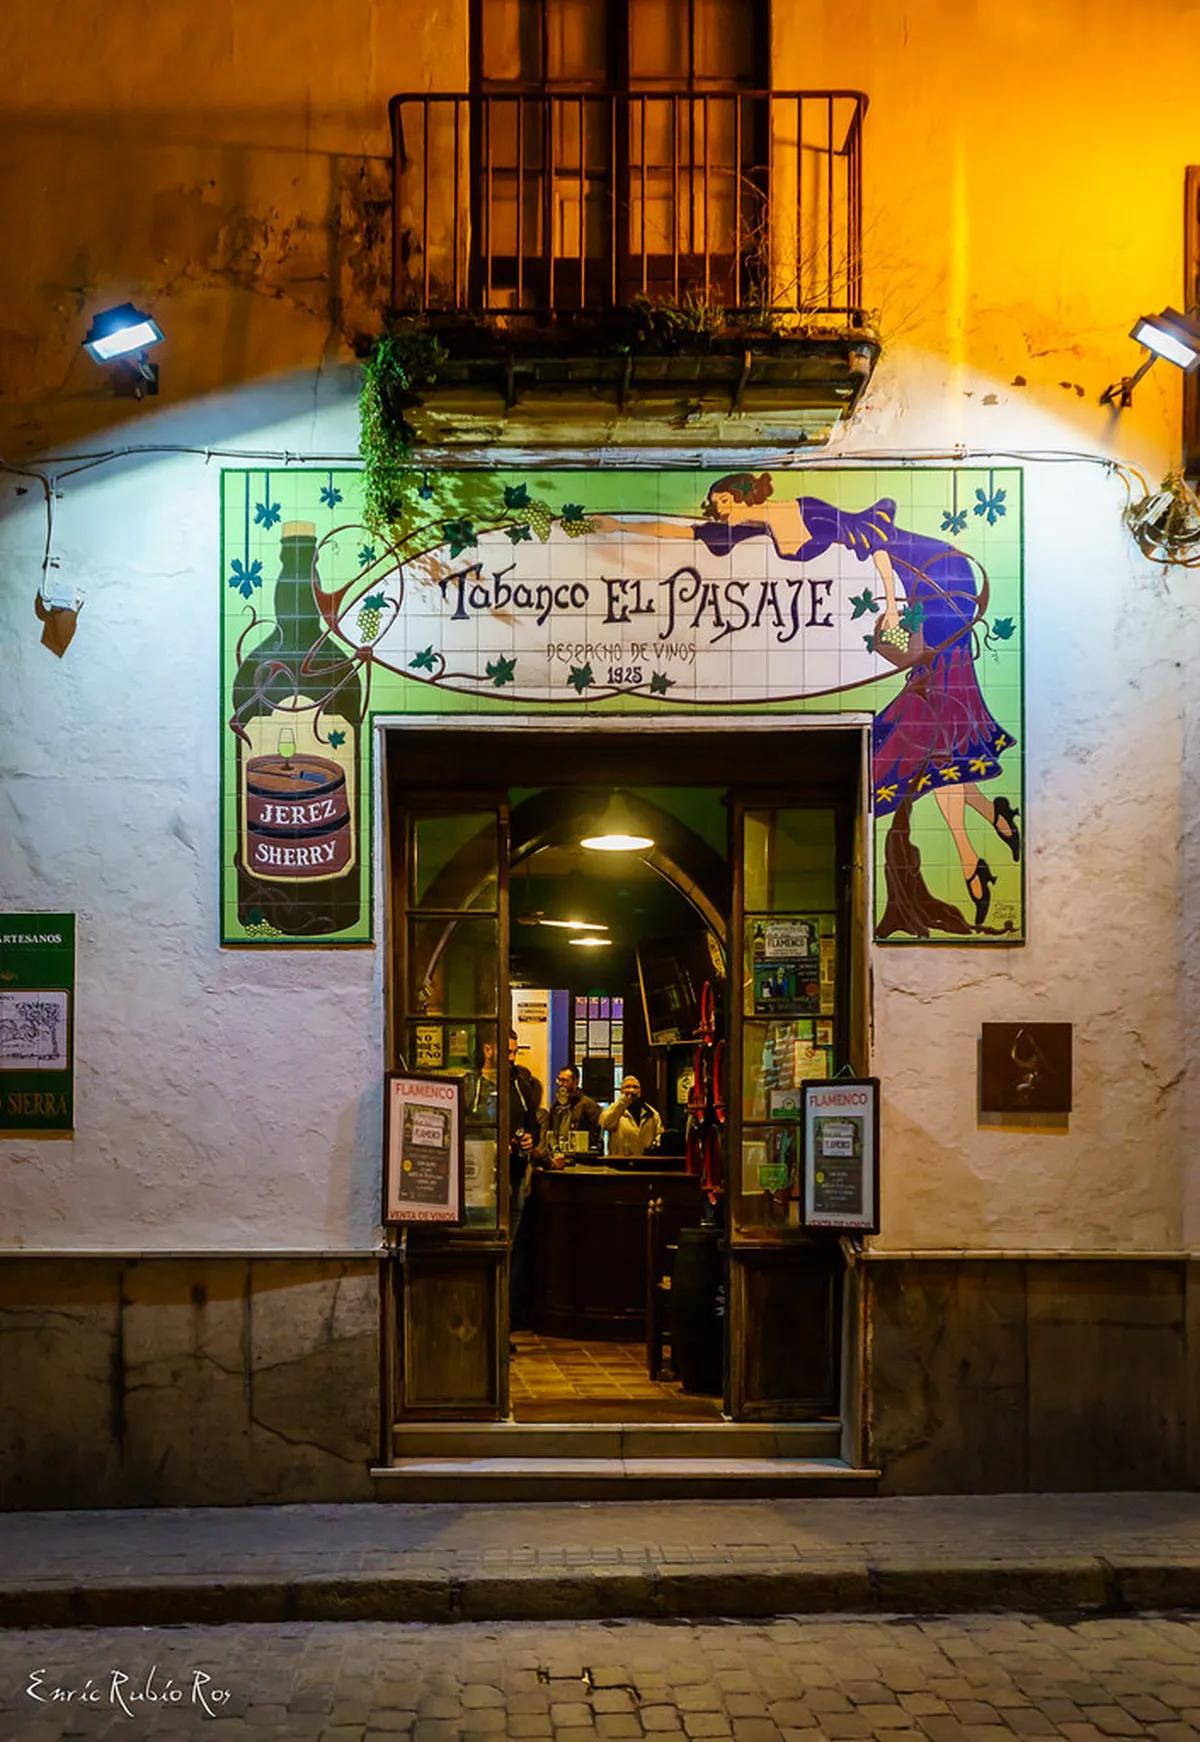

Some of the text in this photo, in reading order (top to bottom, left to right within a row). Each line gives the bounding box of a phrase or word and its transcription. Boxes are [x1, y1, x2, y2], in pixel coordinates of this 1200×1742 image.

[439, 562, 834, 643] Tabanco EL PASAJE
[546, 642, 697, 664] DESPACHO DE VINOS
[607, 666, 643, 684] 1925
[259, 799, 337, 825] JEREZ
[255, 840, 337, 867] SHERRY
[395, 1082, 455, 1100] FLAMENCO
[809, 1092, 869, 1107] FLAMENCO
[7, 1092, 68, 1116] SIERRA
